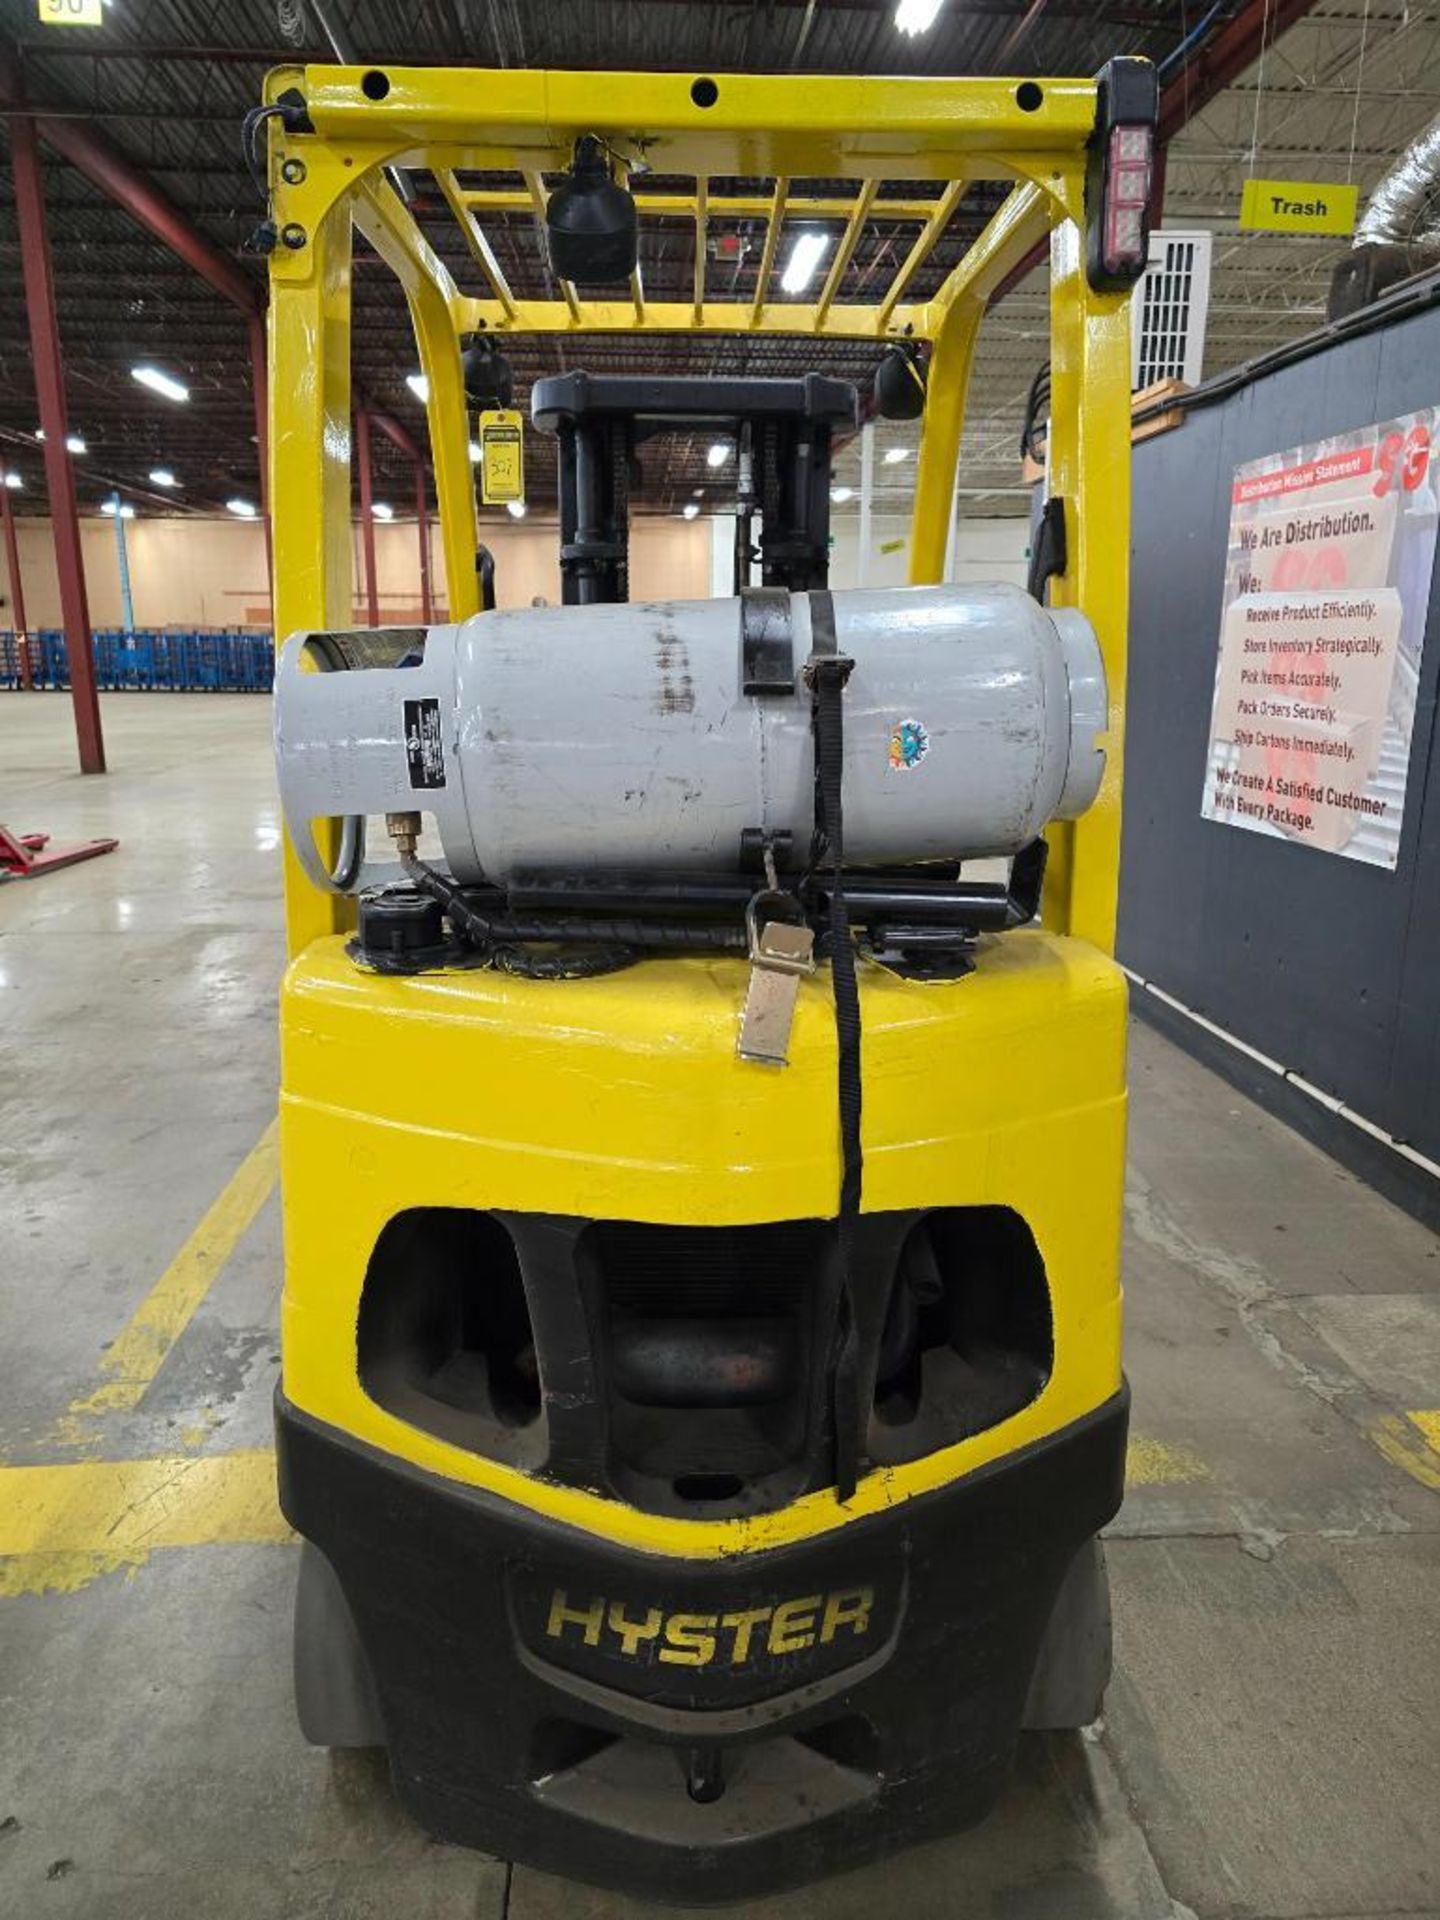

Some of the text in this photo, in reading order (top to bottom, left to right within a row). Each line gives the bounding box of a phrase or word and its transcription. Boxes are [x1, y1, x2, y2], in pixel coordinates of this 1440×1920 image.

[1271, 196, 1328, 217] Trash
[1315, 457, 1361, 481] Statement
[1240, 511, 1374, 550] We Are Distribution.
[1239, 573, 1262, 595] We:
[1246, 600, 1377, 622] Receive Product Efficiently.
[1243, 637, 1383, 657] Store Inventory Strategically.
[1240, 670, 1342, 690] Pick Items Accurately.
[1237, 700, 1336, 724] Pack Orders Securely.
[1234, 729, 1355, 762] Ship Cartons Immediately.
[1216, 767, 1387, 818] We Create A Satisfied Customer
[1214, 791, 1315, 831] With Every Package.
[546, 1587, 874, 1667] HYSTER
